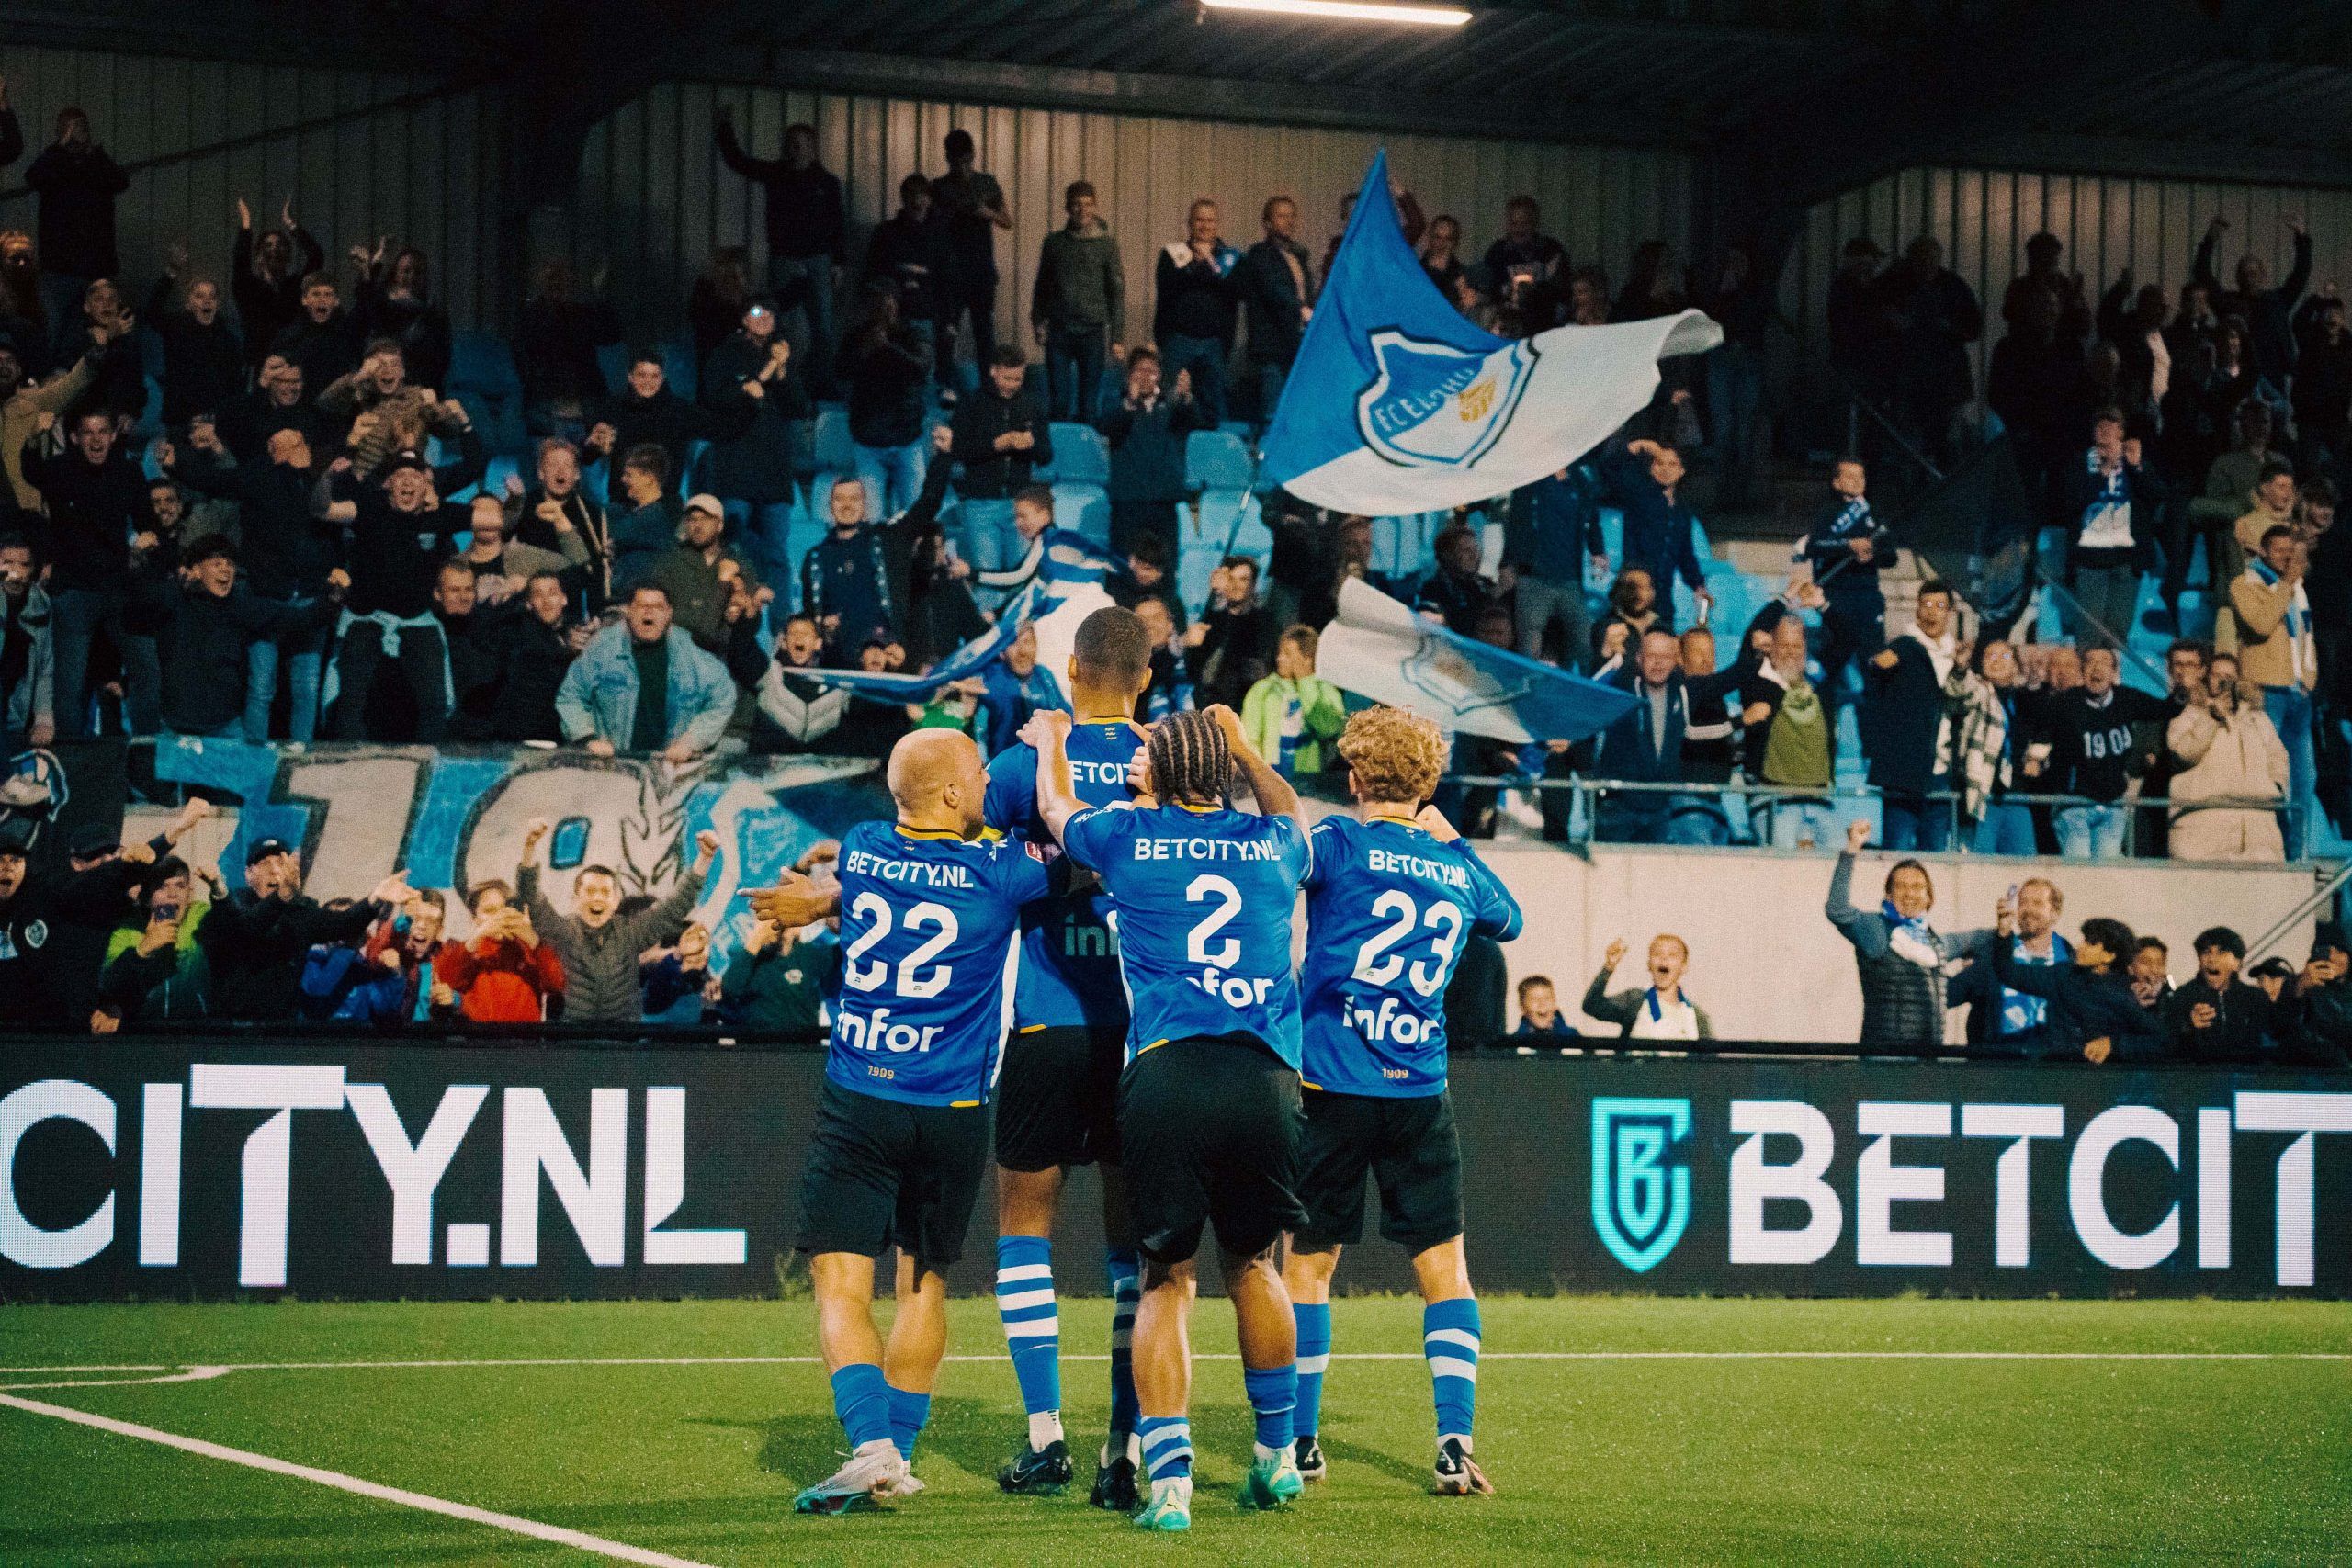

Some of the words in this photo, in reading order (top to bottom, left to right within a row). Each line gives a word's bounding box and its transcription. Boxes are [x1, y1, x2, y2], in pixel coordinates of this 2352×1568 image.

[846, 850, 974, 888] BETCITY.NL
[1134, 837, 1281, 861] BETCITY.NL
[1369, 849, 1470, 889] BETCITY.NL
[844, 891, 959, 998] 22
[1185, 874, 1242, 970] 2
[1351, 888, 1463, 998] 23
[1342, 995, 1440, 1044] infor
[867, 1065, 895, 1080] 1909
[1381, 1067, 1408, 1079] 1909
[0, 1064, 748, 1286] CITY.NL
[1729, 1091, 2352, 1286] BETCIT
